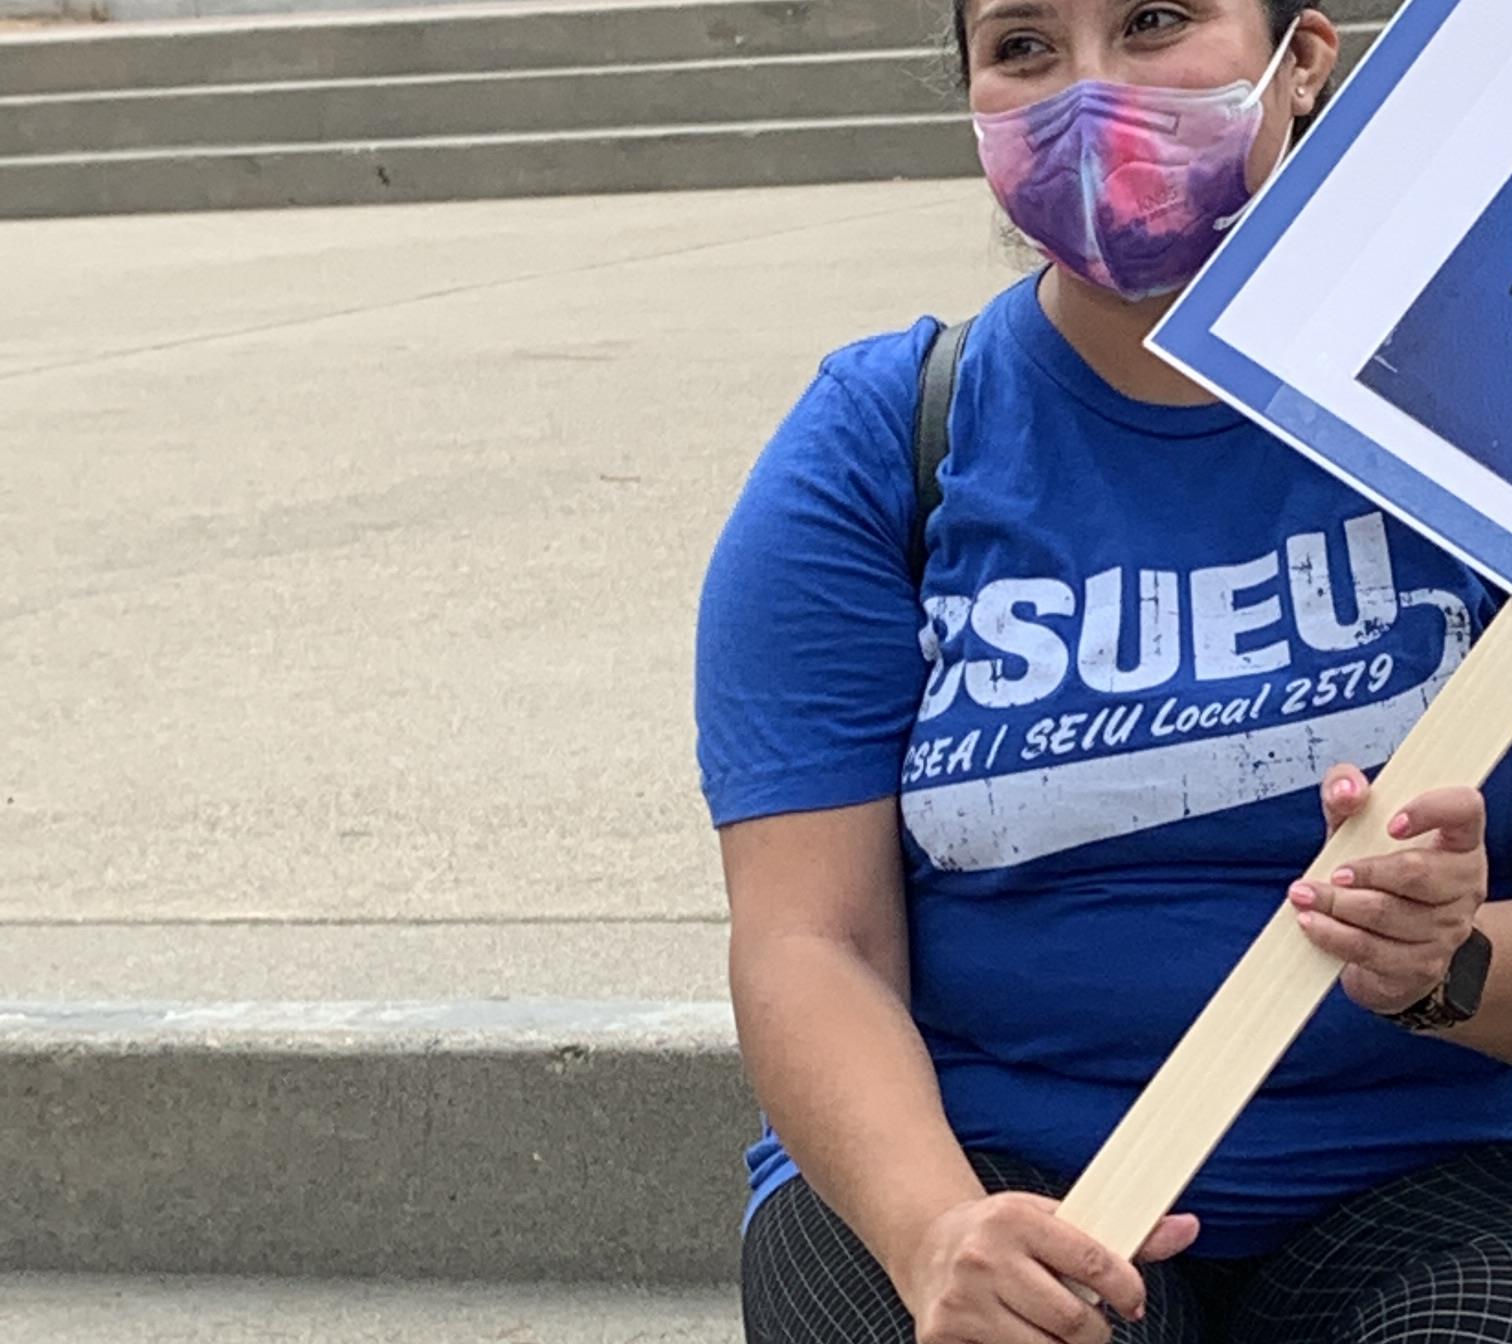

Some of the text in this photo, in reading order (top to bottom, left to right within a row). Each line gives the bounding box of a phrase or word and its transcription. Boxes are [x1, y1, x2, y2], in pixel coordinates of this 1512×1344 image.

[917, 511, 1399, 723] CSUEU
[1020, 700, 1143, 760] SEIU
[1151, 682, 1271, 736] Local
[1281, 652, 1394, 715] 2579
